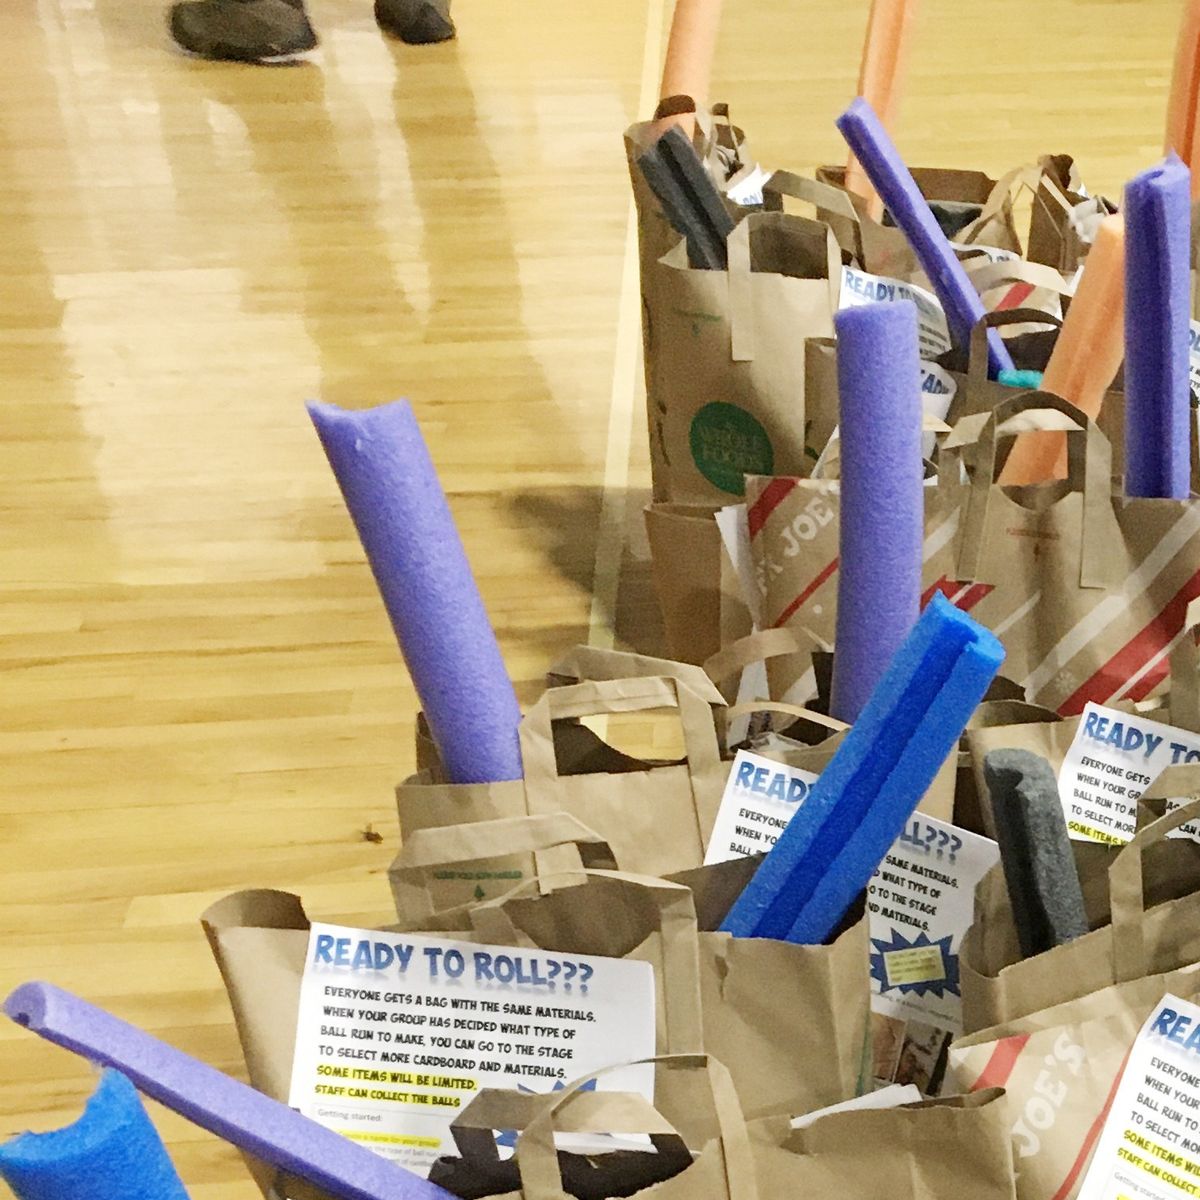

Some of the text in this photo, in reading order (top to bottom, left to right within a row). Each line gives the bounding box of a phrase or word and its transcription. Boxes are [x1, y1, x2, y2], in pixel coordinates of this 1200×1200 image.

[845, 270, 895, 302] READY
[1082, 711, 1164, 758] READY
[735, 761, 814, 802] READ
[1077, 772, 1125, 796] WHEN YOUR
[1081, 755, 1151, 786] EVERYONE GETS
[1073, 787, 1127, 815] BALL RUN TO
[735, 825, 762, 840] WHEN
[738, 808, 787, 829] EVERYONE
[1067, 820, 1091, 835] SOME
[1071, 804, 1136, 834] TO SELECT MOR
[900, 821, 963, 861] LL???
[882, 871, 941, 899] WHAT TYPE OF
[885, 854, 959, 889] SAME MATERIALS.
[878, 886, 937, 916] TO THE STAGE
[315, 933, 594, 992] READY TO ROLL???
[325, 986, 596, 1022] EVERYONE GETS A BAG WITH THE SAME MATERIALS.
[323, 1007, 576, 1039] WHEN YOUR GROUP HAS DECIDED WHAT TYPE OF
[321, 1026, 573, 1059] BALL RUN TO MAKE, YOU CAN GO TO THE STAGE
[1151, 1057, 1200, 1087] EVERYONE
[1011, 1029, 1086, 1158] JOE'S
